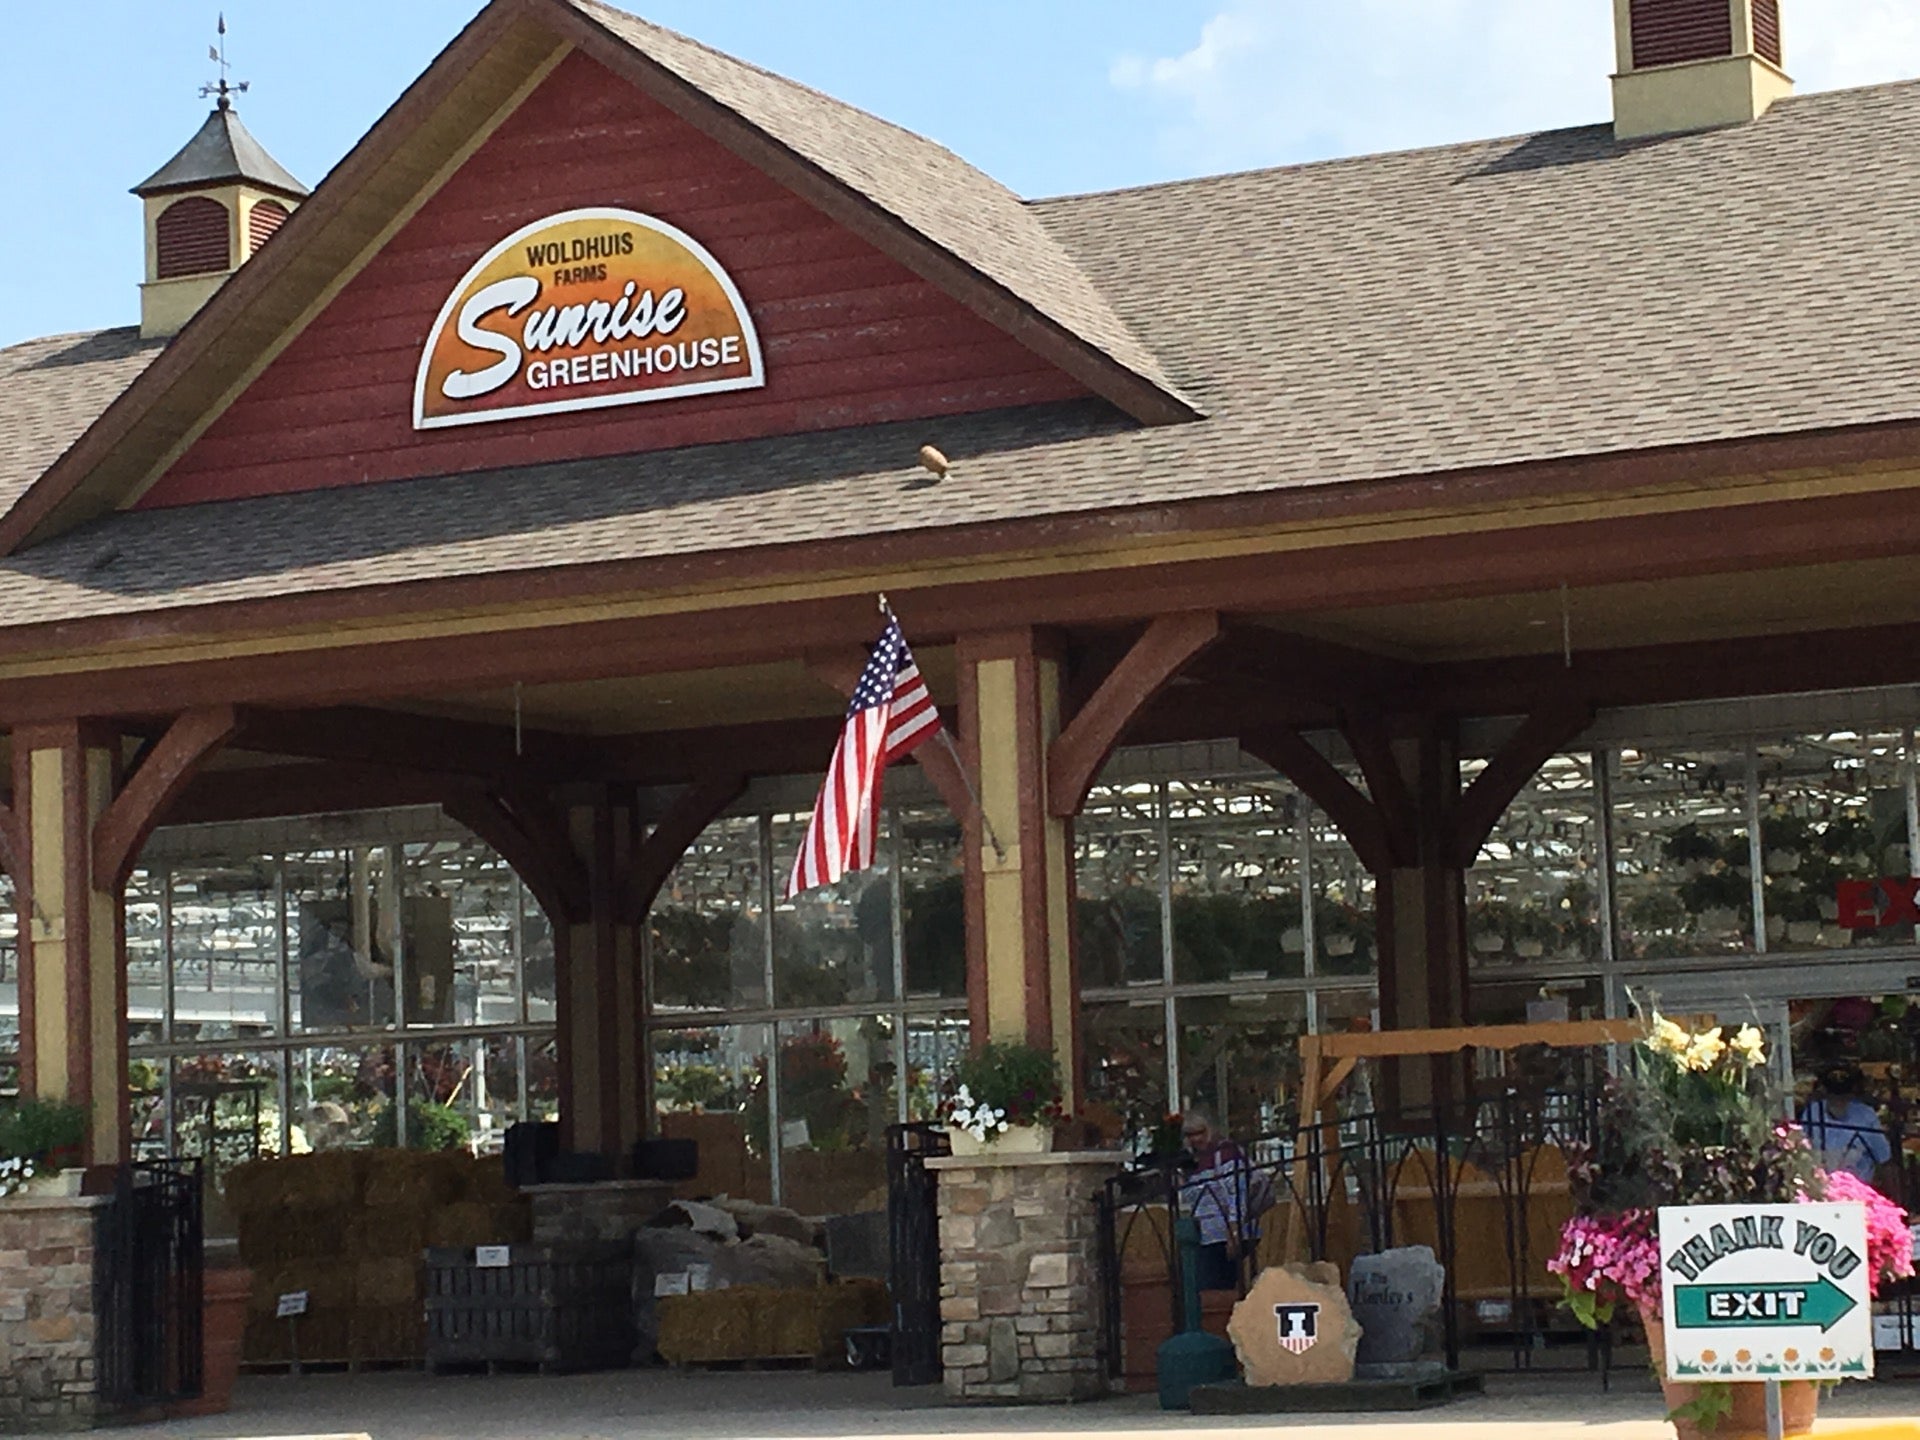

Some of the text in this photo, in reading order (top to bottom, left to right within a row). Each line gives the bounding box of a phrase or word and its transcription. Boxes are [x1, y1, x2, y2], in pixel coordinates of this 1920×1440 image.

[526, 232, 633, 268] WOLDHUIS
[554, 263, 607, 286] FARMS
[442, 276, 687, 398] Sunrise
[526, 335, 741, 389] GREENHOUSE
[1666, 1215, 1862, 1282] THANK YOU
[1707, 1290, 1806, 1318] EXIT
